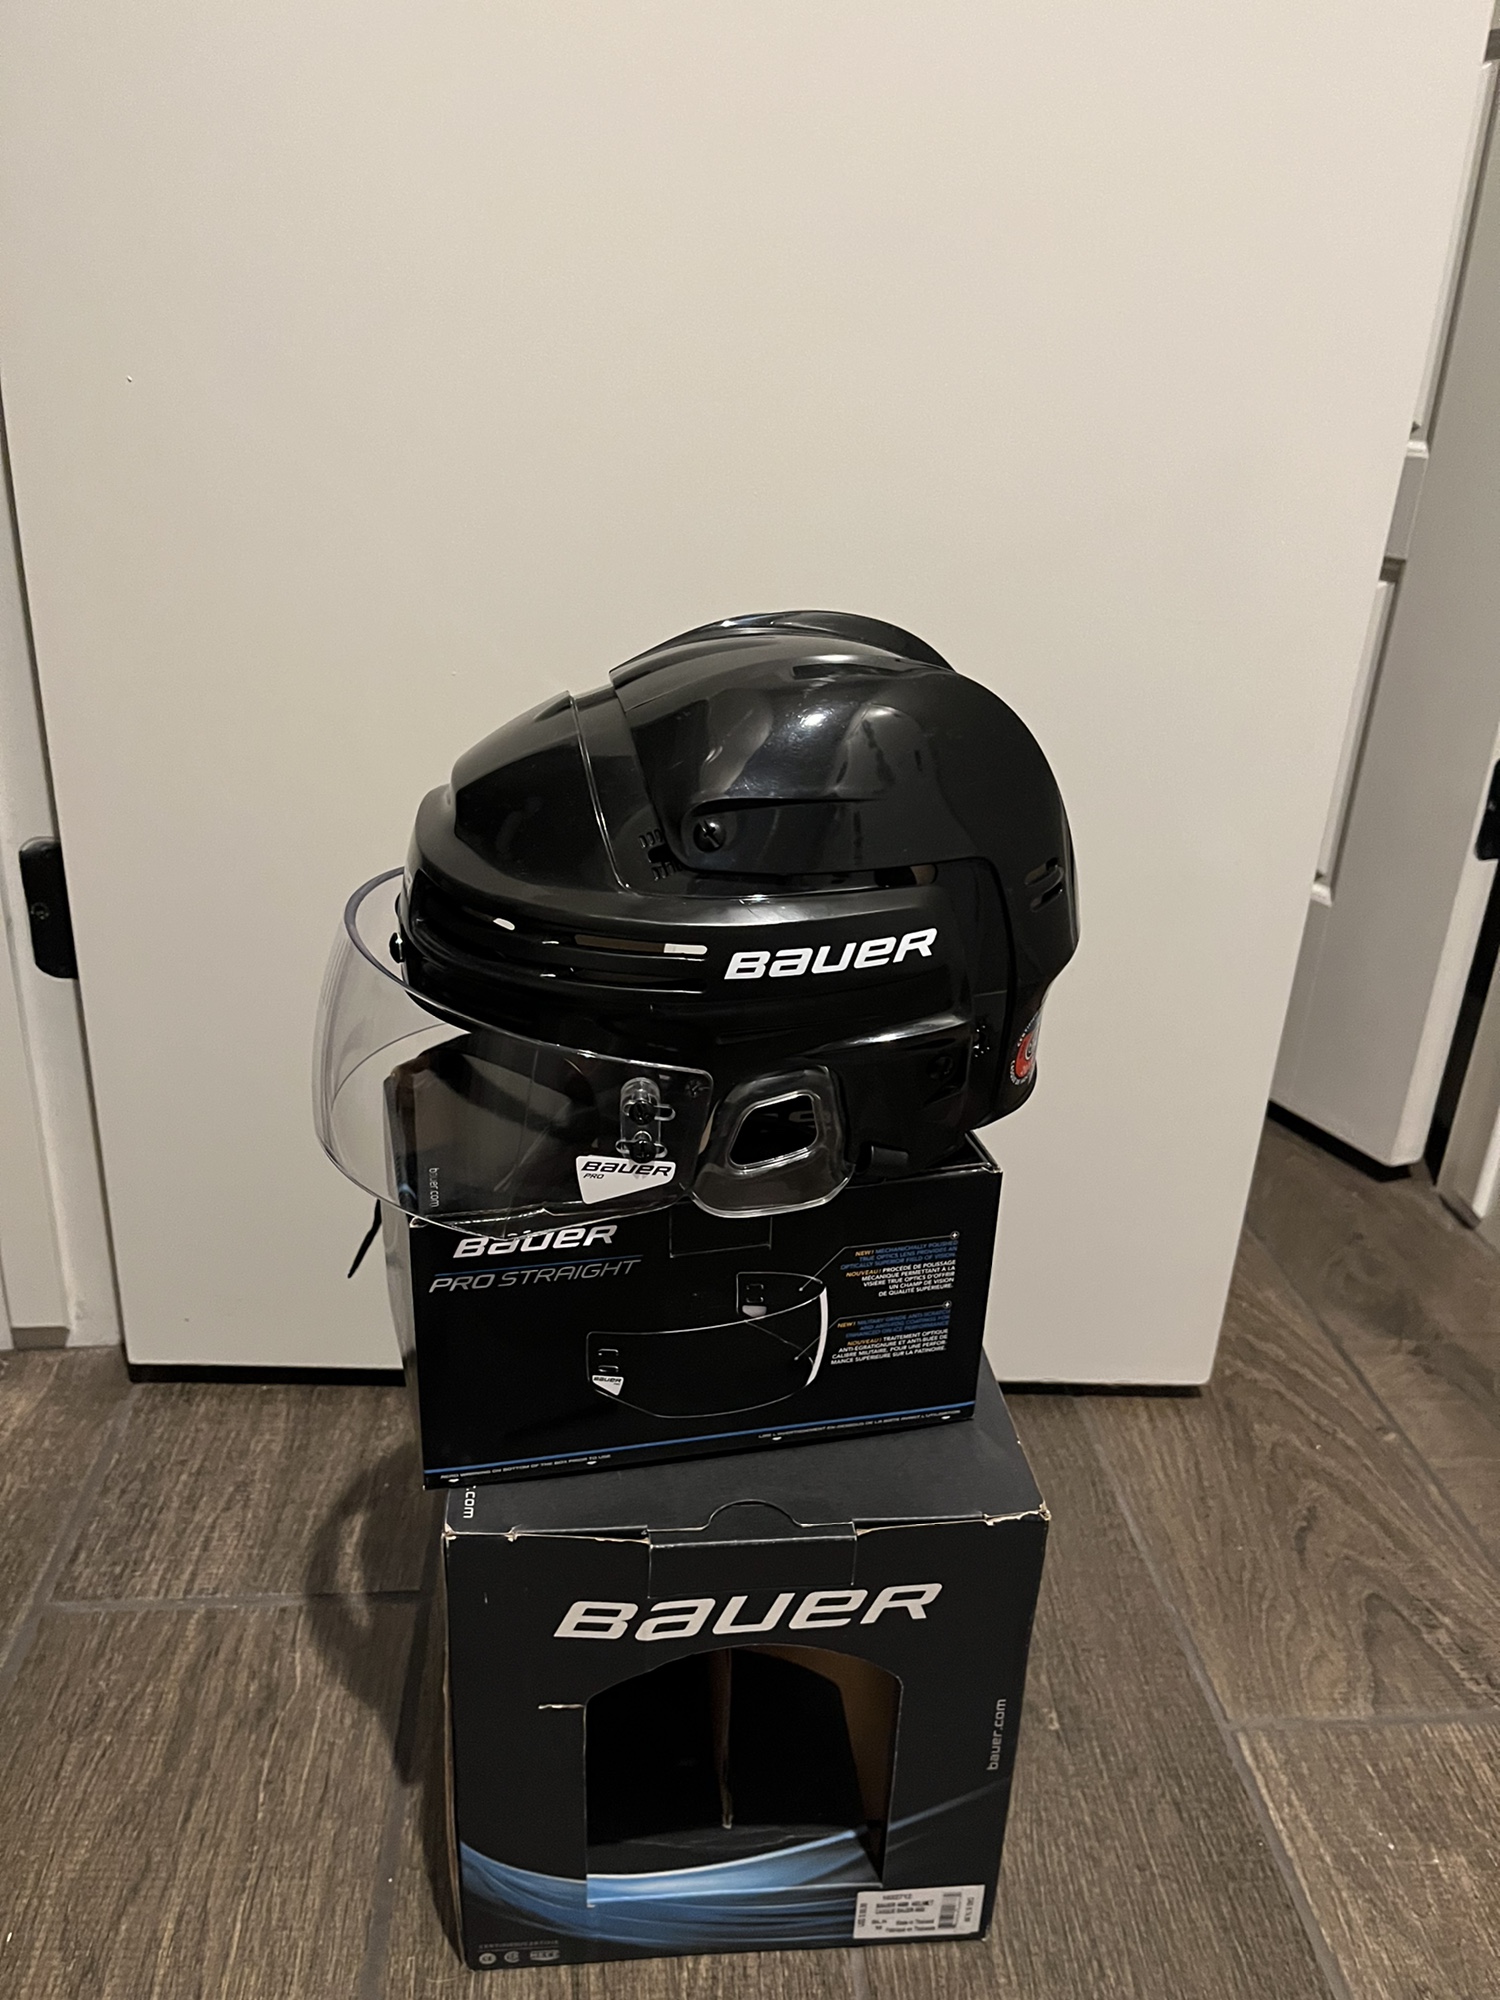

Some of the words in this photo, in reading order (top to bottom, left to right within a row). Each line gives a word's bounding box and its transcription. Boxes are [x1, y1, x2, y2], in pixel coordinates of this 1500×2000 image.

[429, 1274, 495, 1293] PRO
[498, 1260, 641, 1287] STRAIGHT
[986, 1698, 1006, 1770] bauer.com
